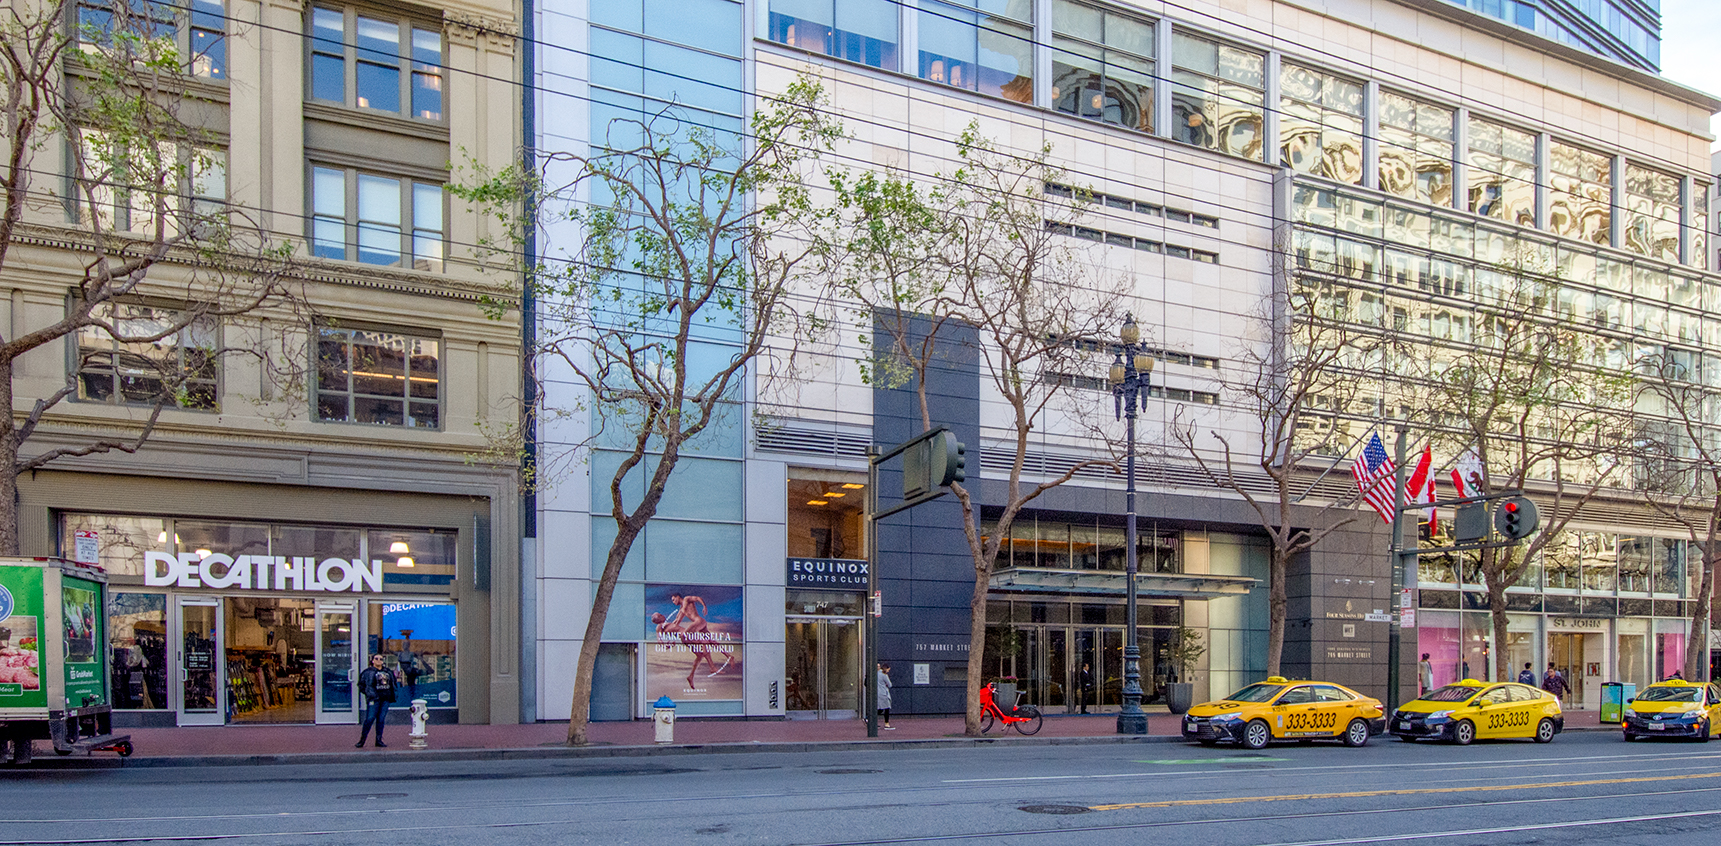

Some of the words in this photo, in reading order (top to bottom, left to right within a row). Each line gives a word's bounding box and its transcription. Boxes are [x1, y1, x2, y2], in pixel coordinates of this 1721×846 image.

[145, 550, 382, 592] DECATHLON
[793, 561, 868, 574] EQUINOX
[793, 574, 836, 582] SPORTS
[840, 576, 868, 584] CLUB
[1571, 619, 1601, 628] JOHN
[659, 632, 681, 641] MAKE
[683, 632, 724, 641] YOURSELF
[725, 632, 731, 641] A
[655, 644, 673, 652] GIFT
[676, 644, 686, 652] TO
[688, 644, 703, 652] THE
[706, 644, 734, 653] WORLD
[1286, 712, 1337, 730] 333-3333
[1488, 711, 1530, 729] 333-3333
